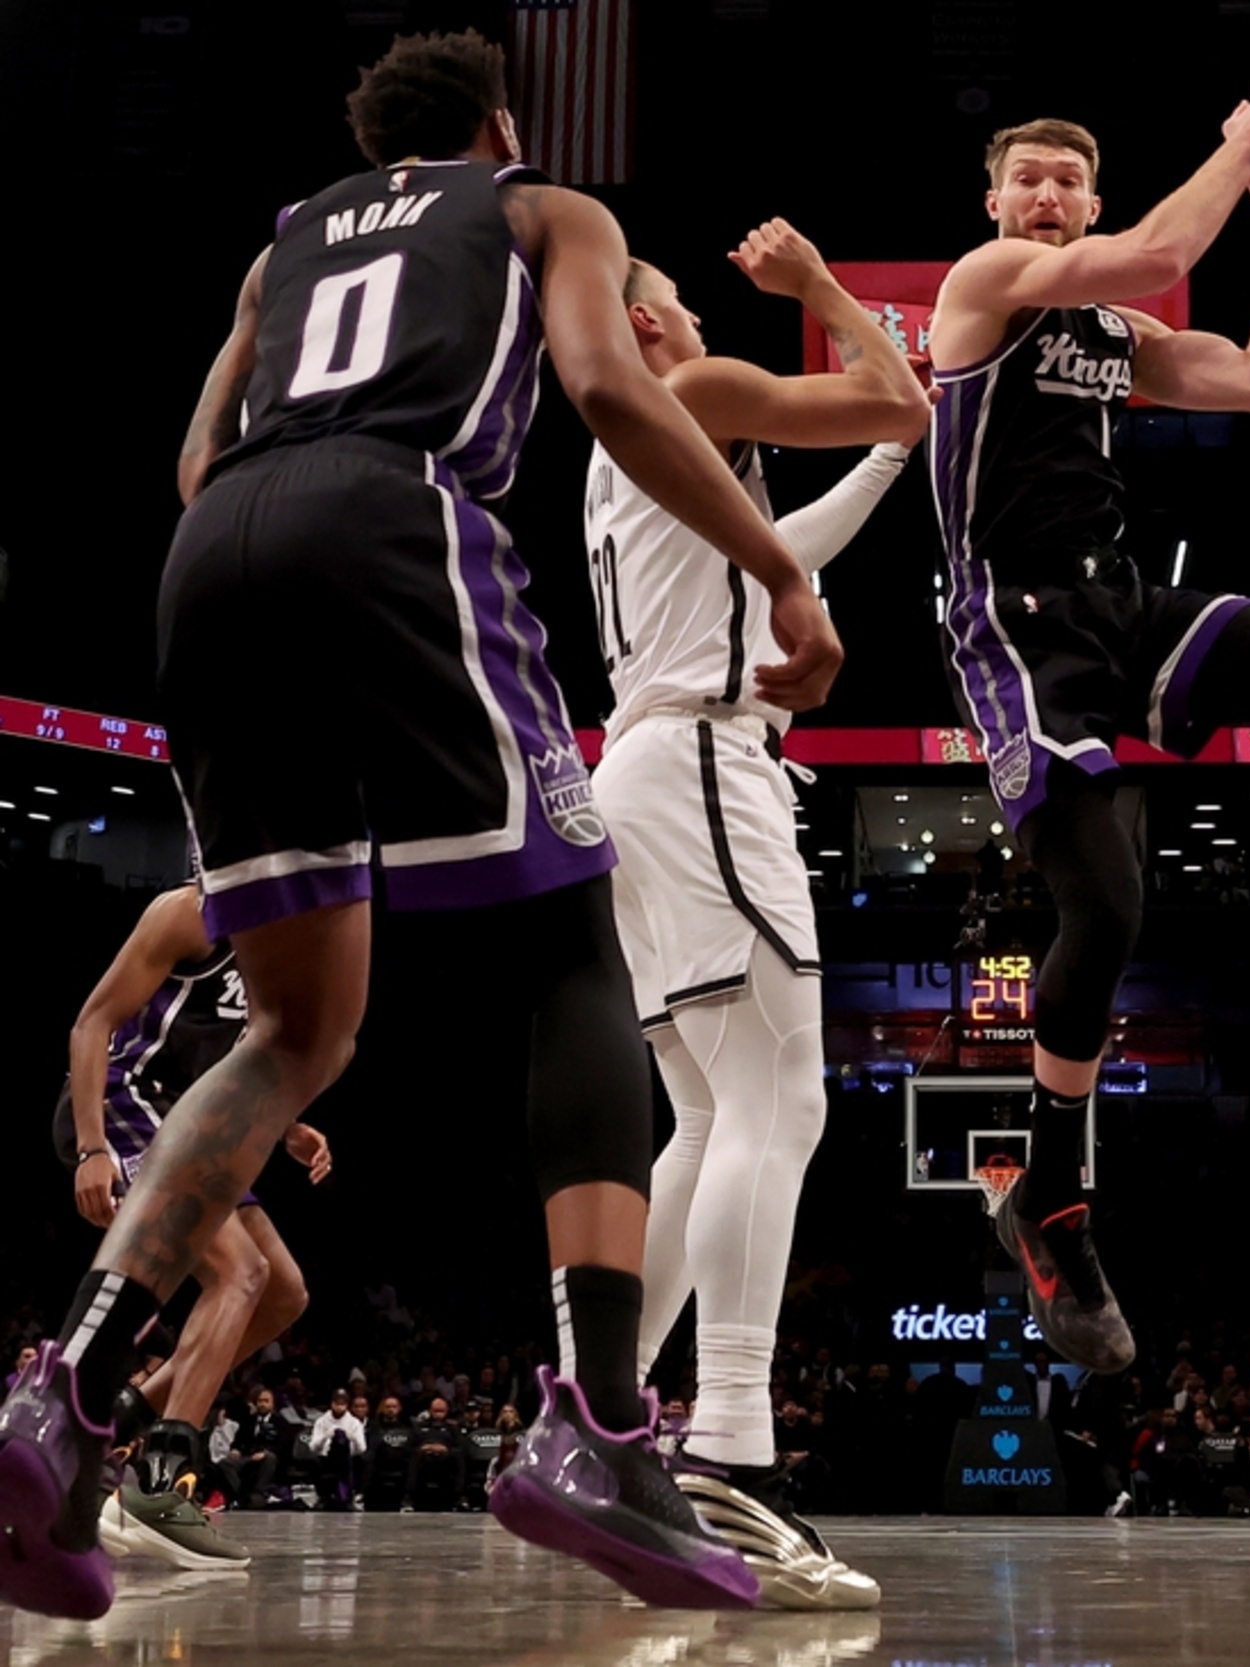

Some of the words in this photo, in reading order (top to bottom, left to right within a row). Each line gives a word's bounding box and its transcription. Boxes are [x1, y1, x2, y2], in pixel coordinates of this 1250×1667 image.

[325, 190, 443, 246] MONK
[288, 252, 403, 399] 0
[1033, 331, 1132, 402] Kings
[100, 718, 127, 734] REB
[546, 784, 594, 816] KING
[980, 956, 1031, 979] 4:52
[971, 980, 1026, 1019] 24
[983, 1029, 1036, 1039] TISSOT
[980, 1405, 1031, 1416] BARCLAYS
[962, 1468, 1052, 1486] BARCLAYS
